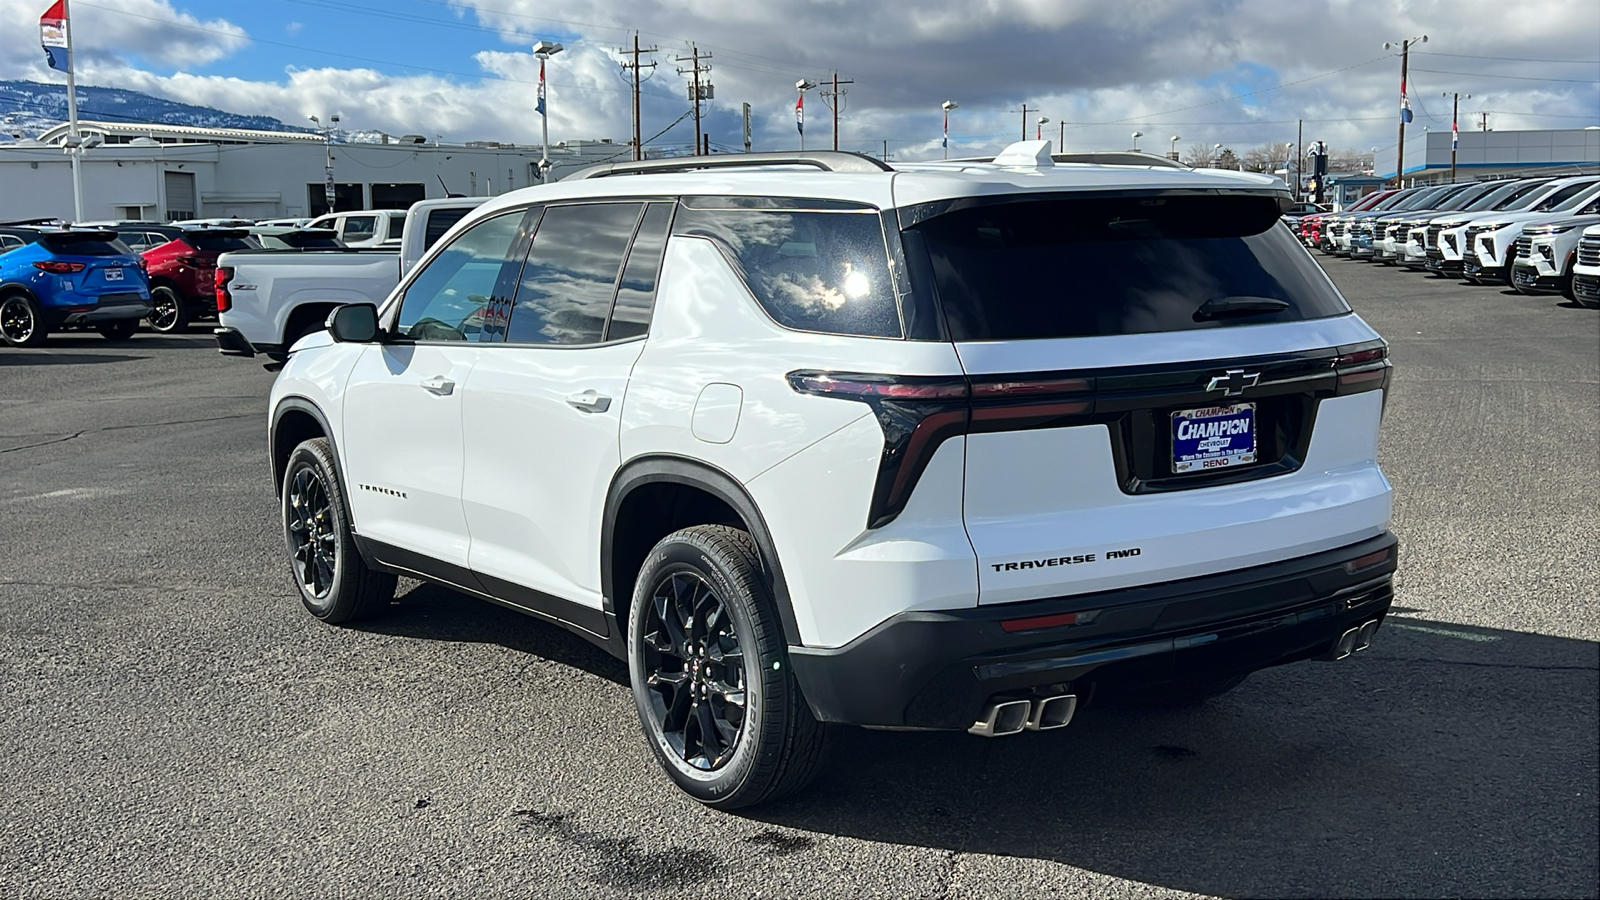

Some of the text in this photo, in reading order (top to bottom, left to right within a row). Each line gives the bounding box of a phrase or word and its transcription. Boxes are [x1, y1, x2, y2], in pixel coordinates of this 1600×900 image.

[1195, 406, 1236, 418] CHAMPION
[1177, 418, 1250, 441] CHAMPION
[1200, 439, 1230, 449] CHEVROLET
[1203, 458, 1229, 468] RENO
[358, 484, 408, 499] TRAVERSE
[992, 547, 1142, 572] TRAVERSE AWD
